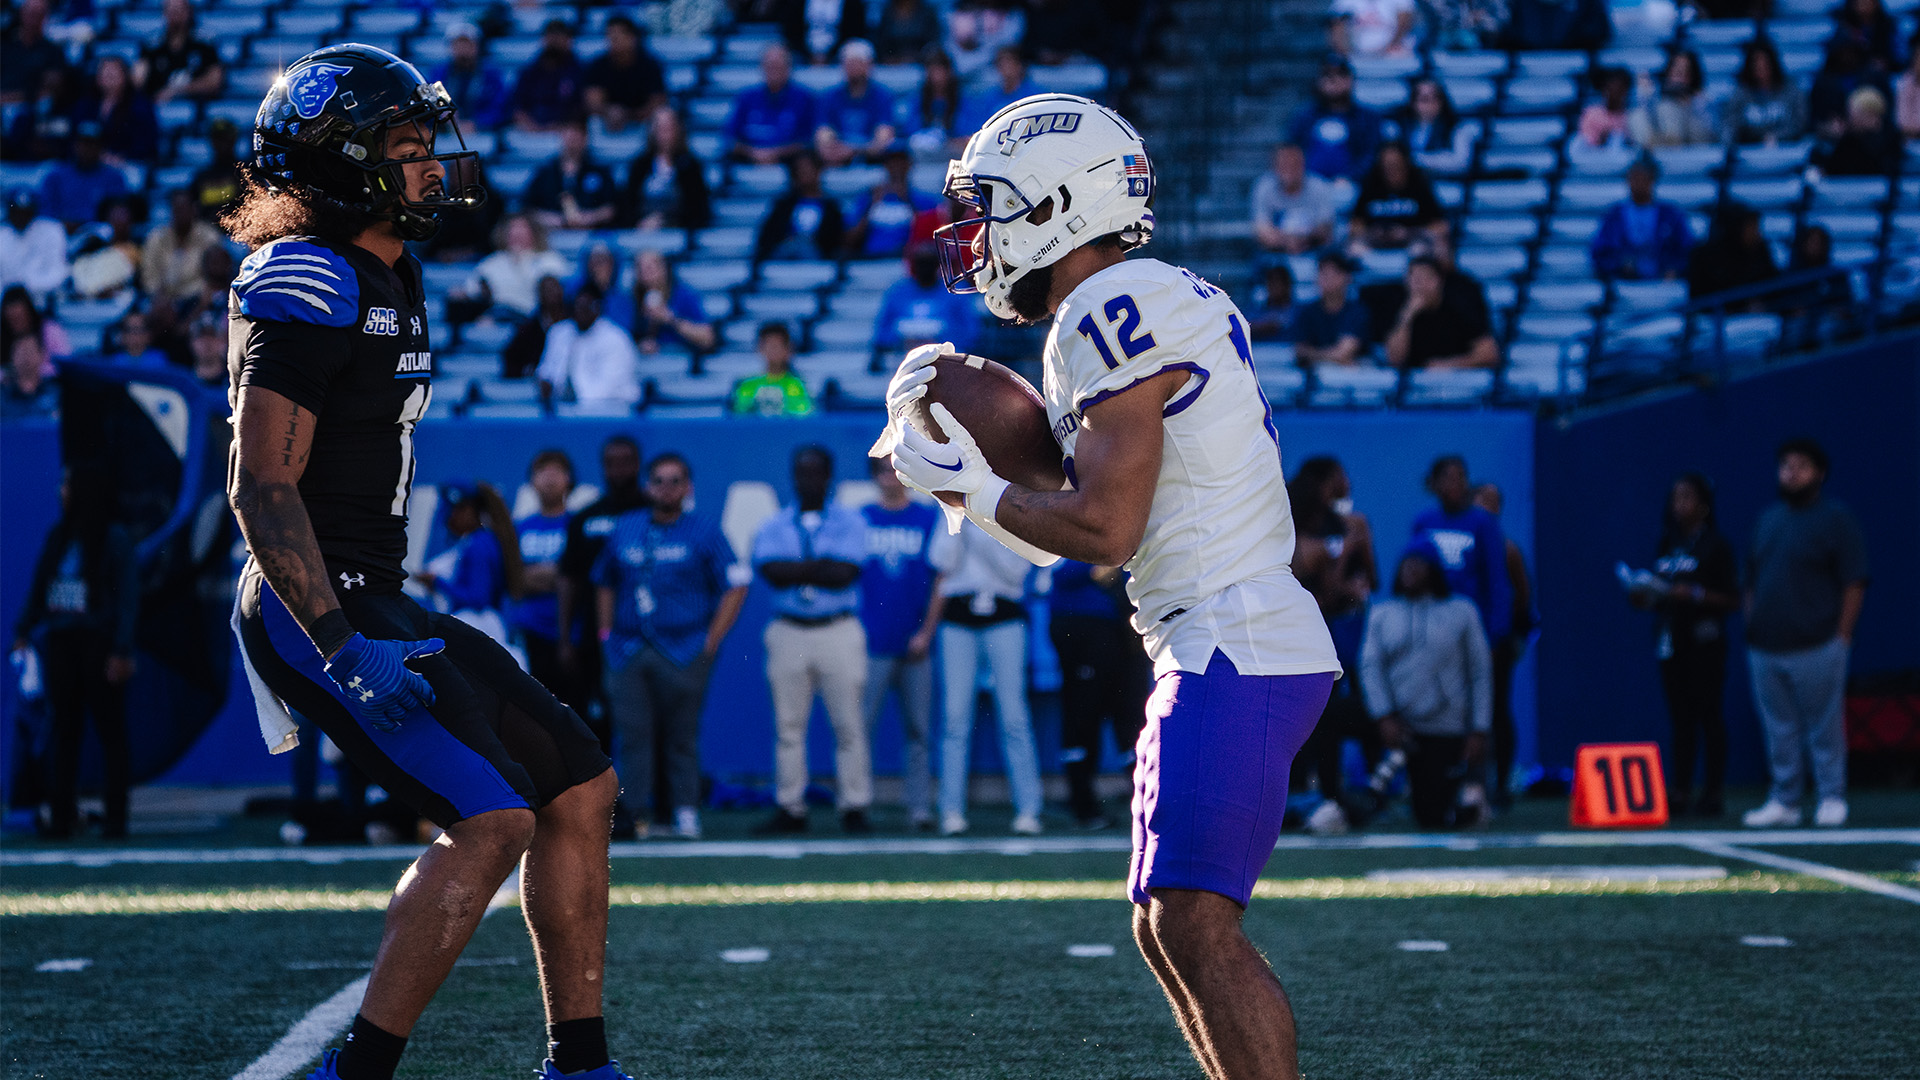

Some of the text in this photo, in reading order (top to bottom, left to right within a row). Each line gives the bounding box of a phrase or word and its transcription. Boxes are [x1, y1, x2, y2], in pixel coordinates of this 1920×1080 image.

[997, 112, 1083, 145] JMU
[363, 306, 400, 337] SBC
[1075, 293, 1160, 372] 12
[1595, 756, 1654, 815] 10
